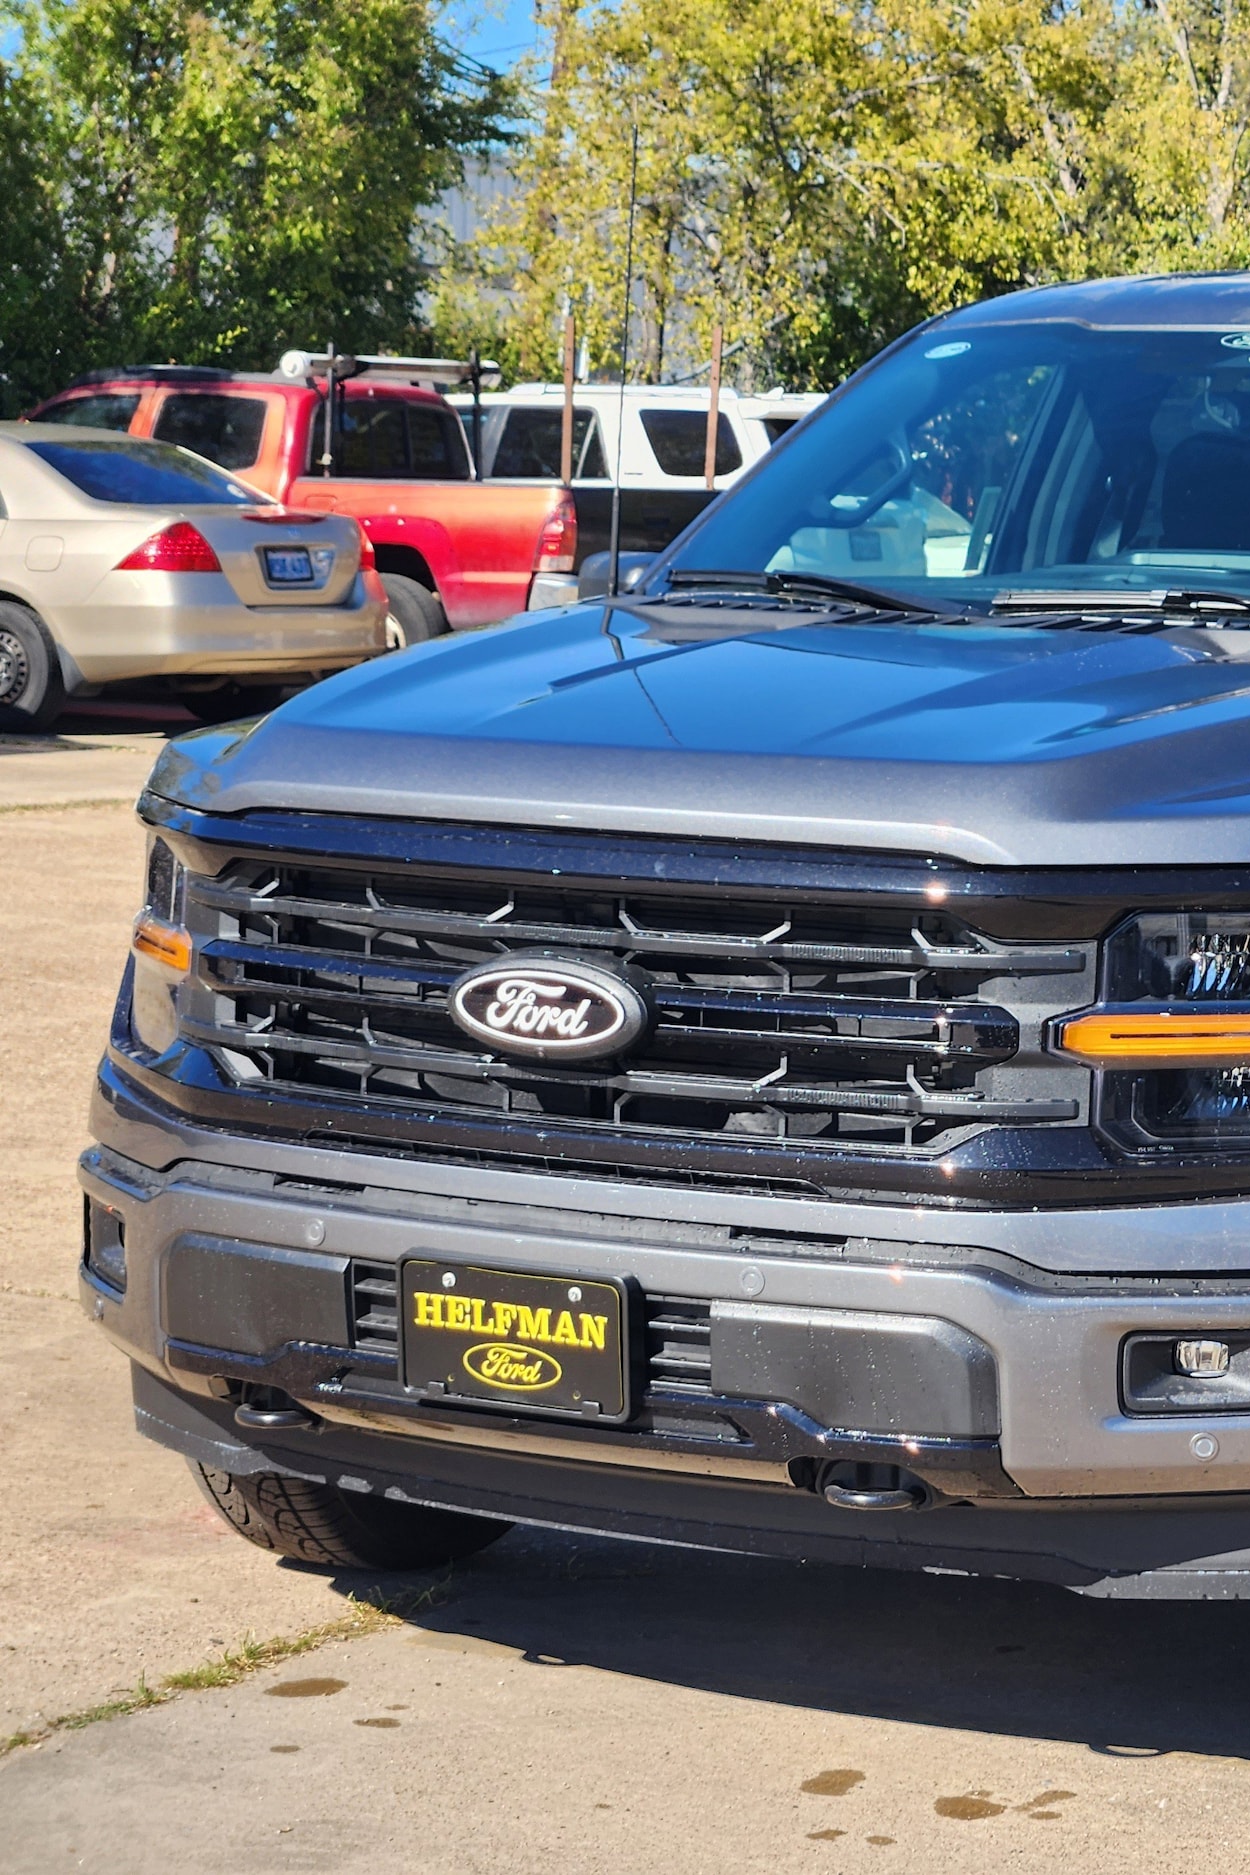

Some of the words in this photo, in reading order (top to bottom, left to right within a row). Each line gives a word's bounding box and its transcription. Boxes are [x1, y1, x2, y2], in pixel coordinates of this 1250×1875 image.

[486, 979, 592, 1036] Ford
[413, 1292, 608, 1350] HELFMAN
[481, 1347, 543, 1384] Ford
